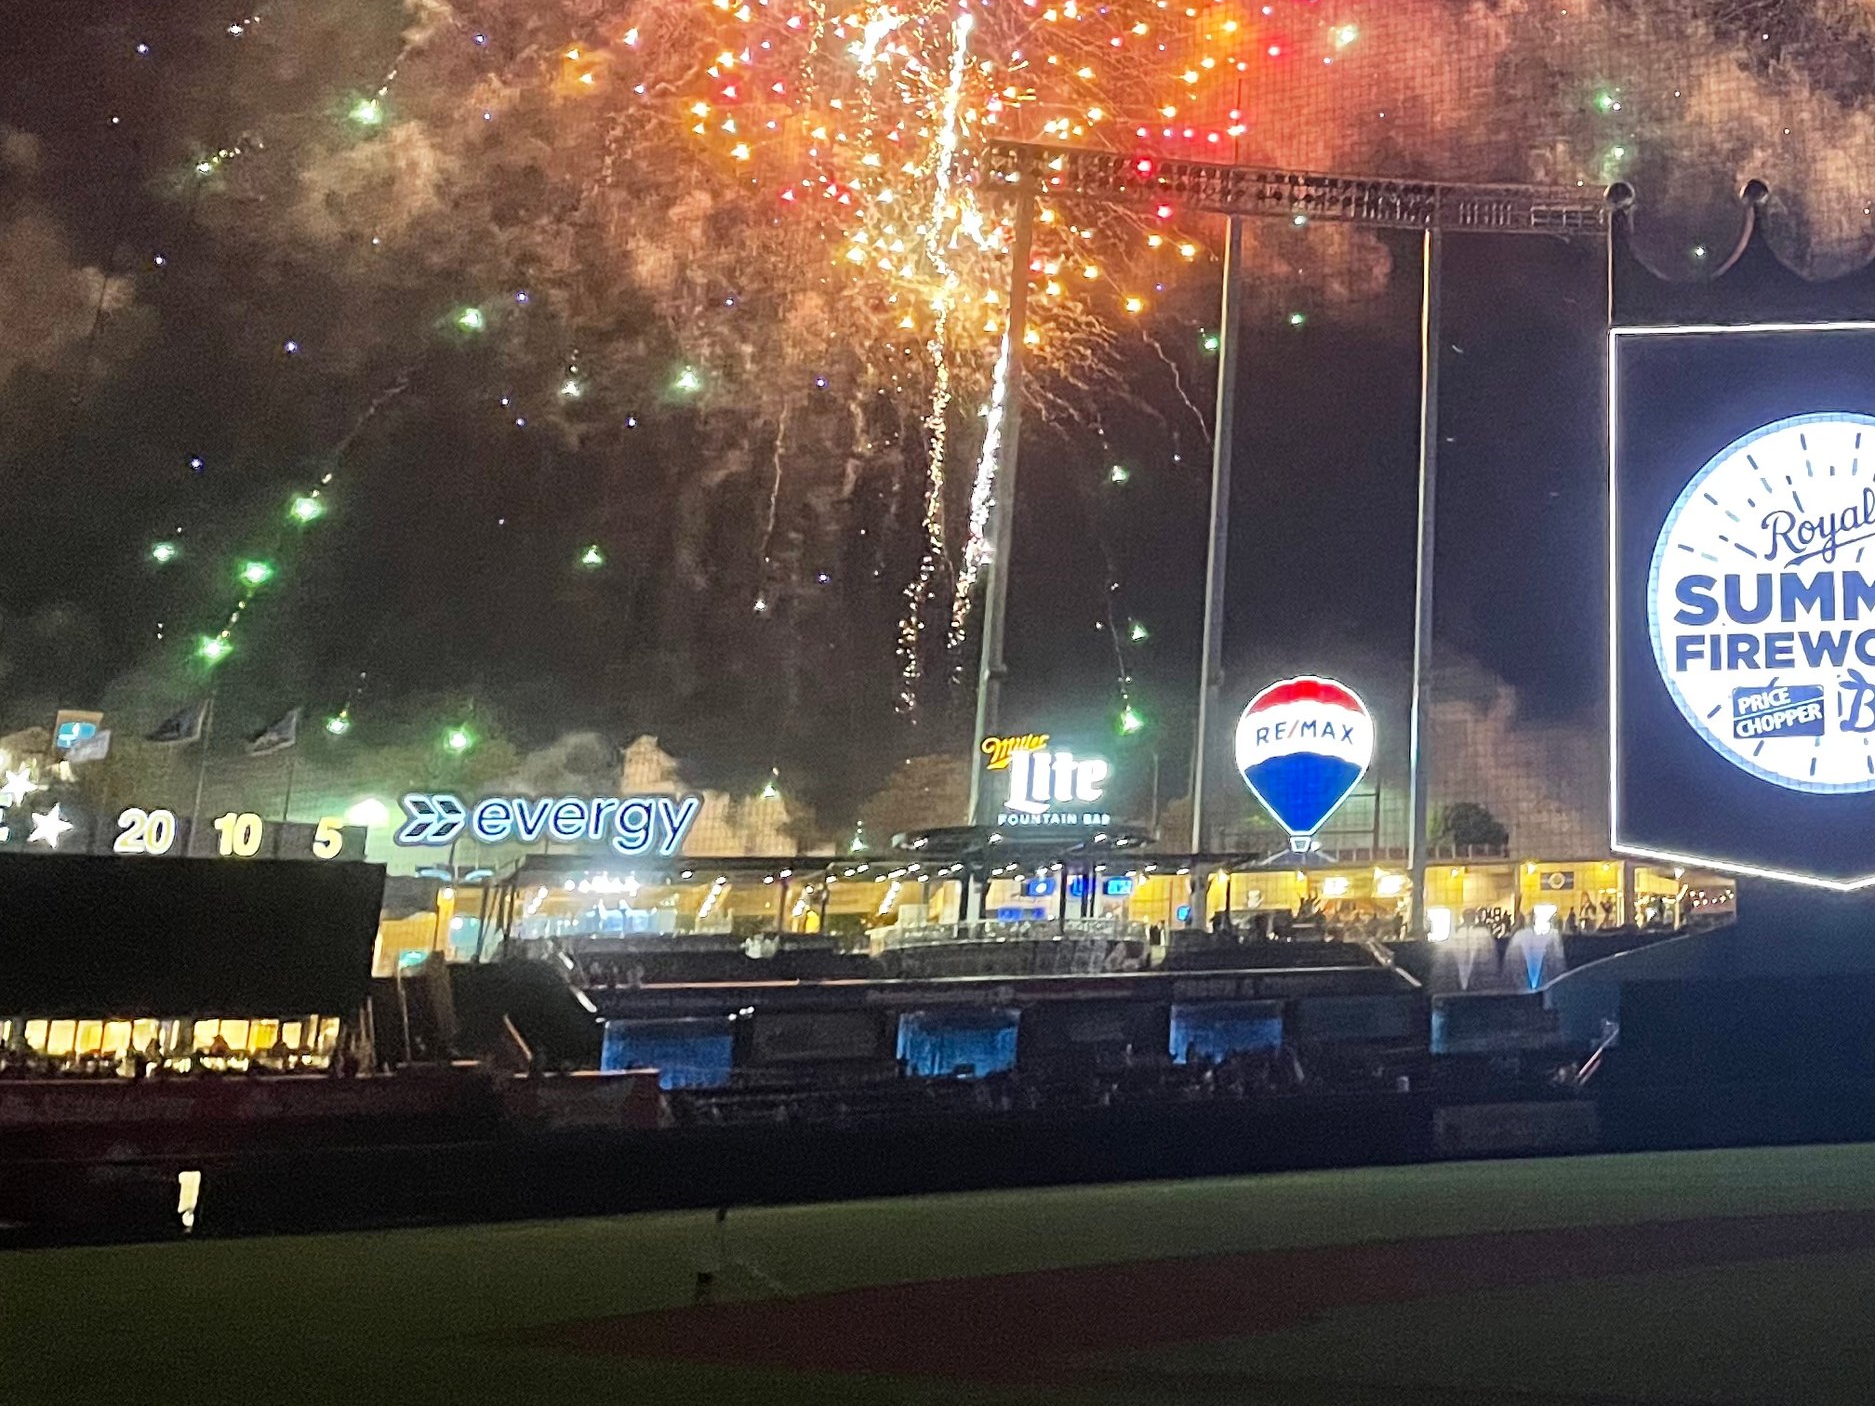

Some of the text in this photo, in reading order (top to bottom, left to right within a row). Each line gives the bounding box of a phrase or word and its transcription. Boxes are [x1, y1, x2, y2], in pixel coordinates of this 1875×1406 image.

[1737, 686, 1791, 715] PRICE
[1255, 719, 1354, 746] RE/MAX
[1735, 703, 1823, 738] CHOPPER
[981, 733, 1050, 770] Miller
[1003, 749, 1109, 815] Lite
[113, 807, 343, 859] 20 10 5
[472, 795, 700, 856] evergy
[997, 813, 1078, 825] FOUNTAIN
